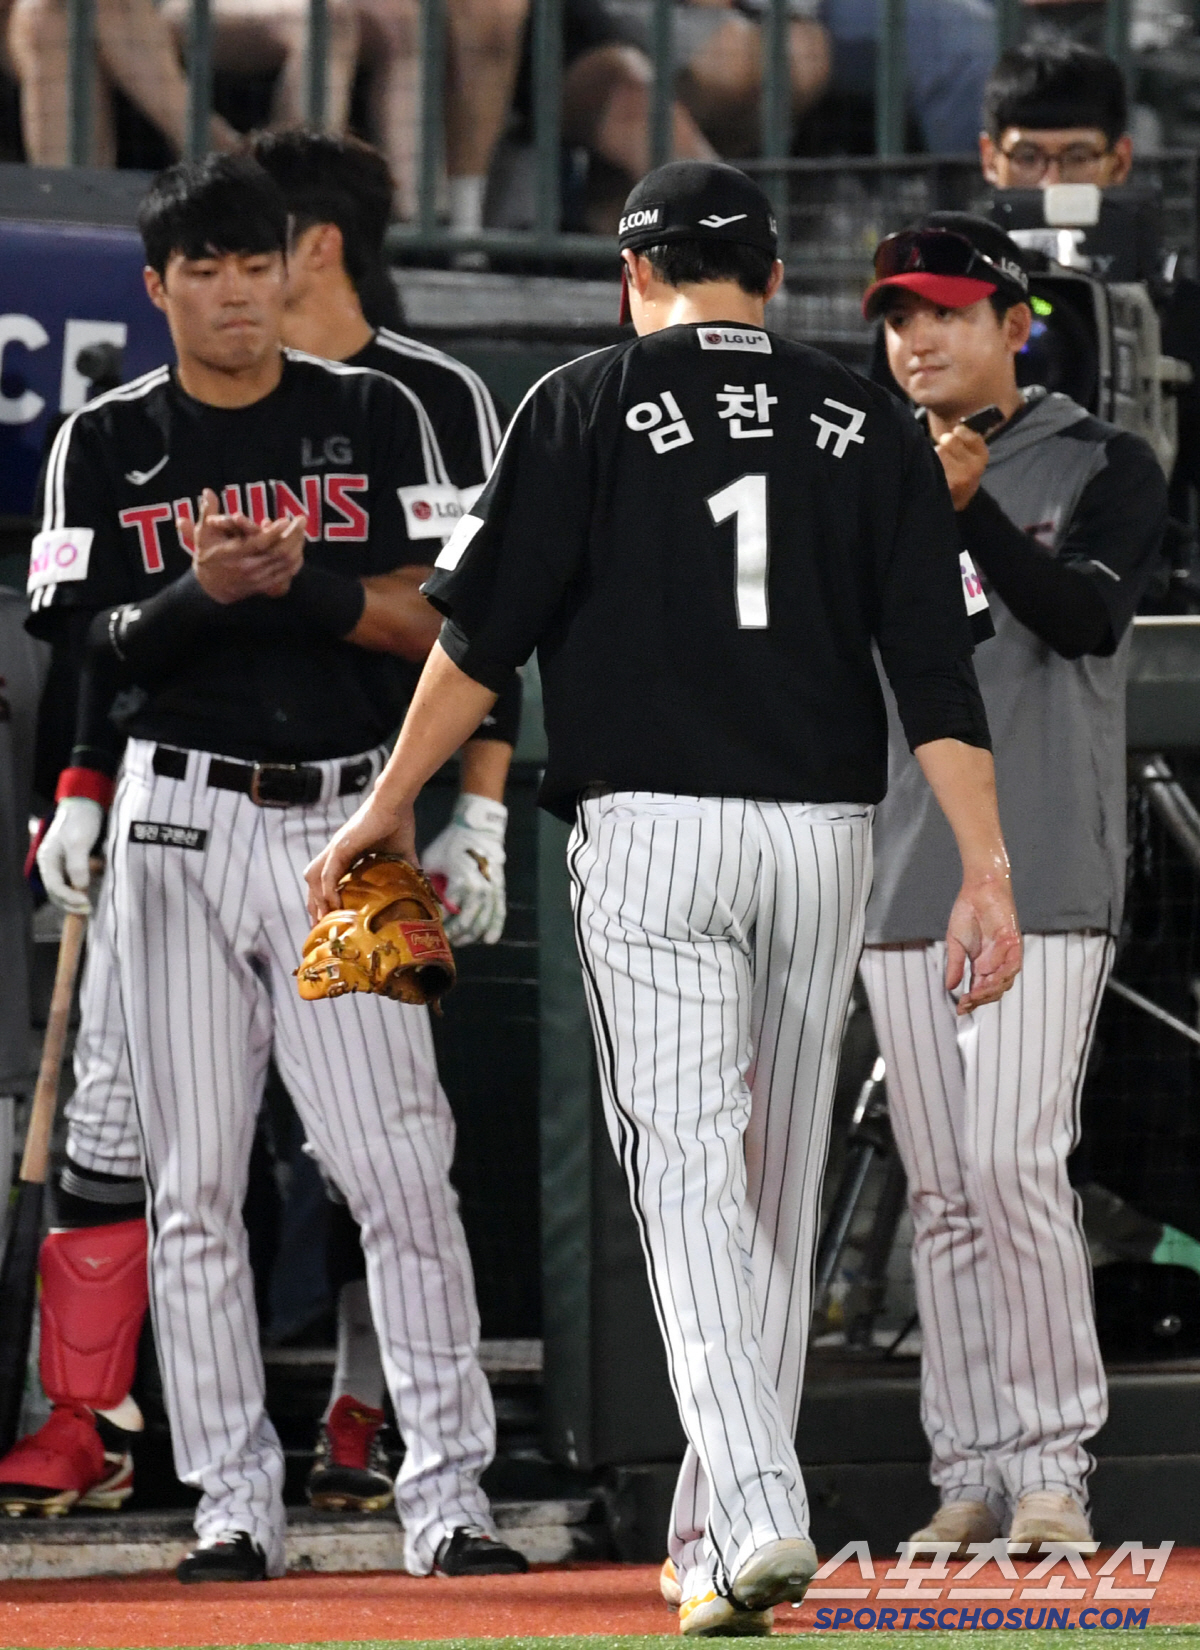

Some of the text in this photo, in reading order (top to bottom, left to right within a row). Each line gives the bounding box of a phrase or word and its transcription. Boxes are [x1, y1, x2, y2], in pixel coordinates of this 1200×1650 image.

[724, 334, 764, 345] LG U+
[625, 383, 867, 459] 임찬규
[301, 436, 353, 467] LG
[704, 472, 769, 630] 1
